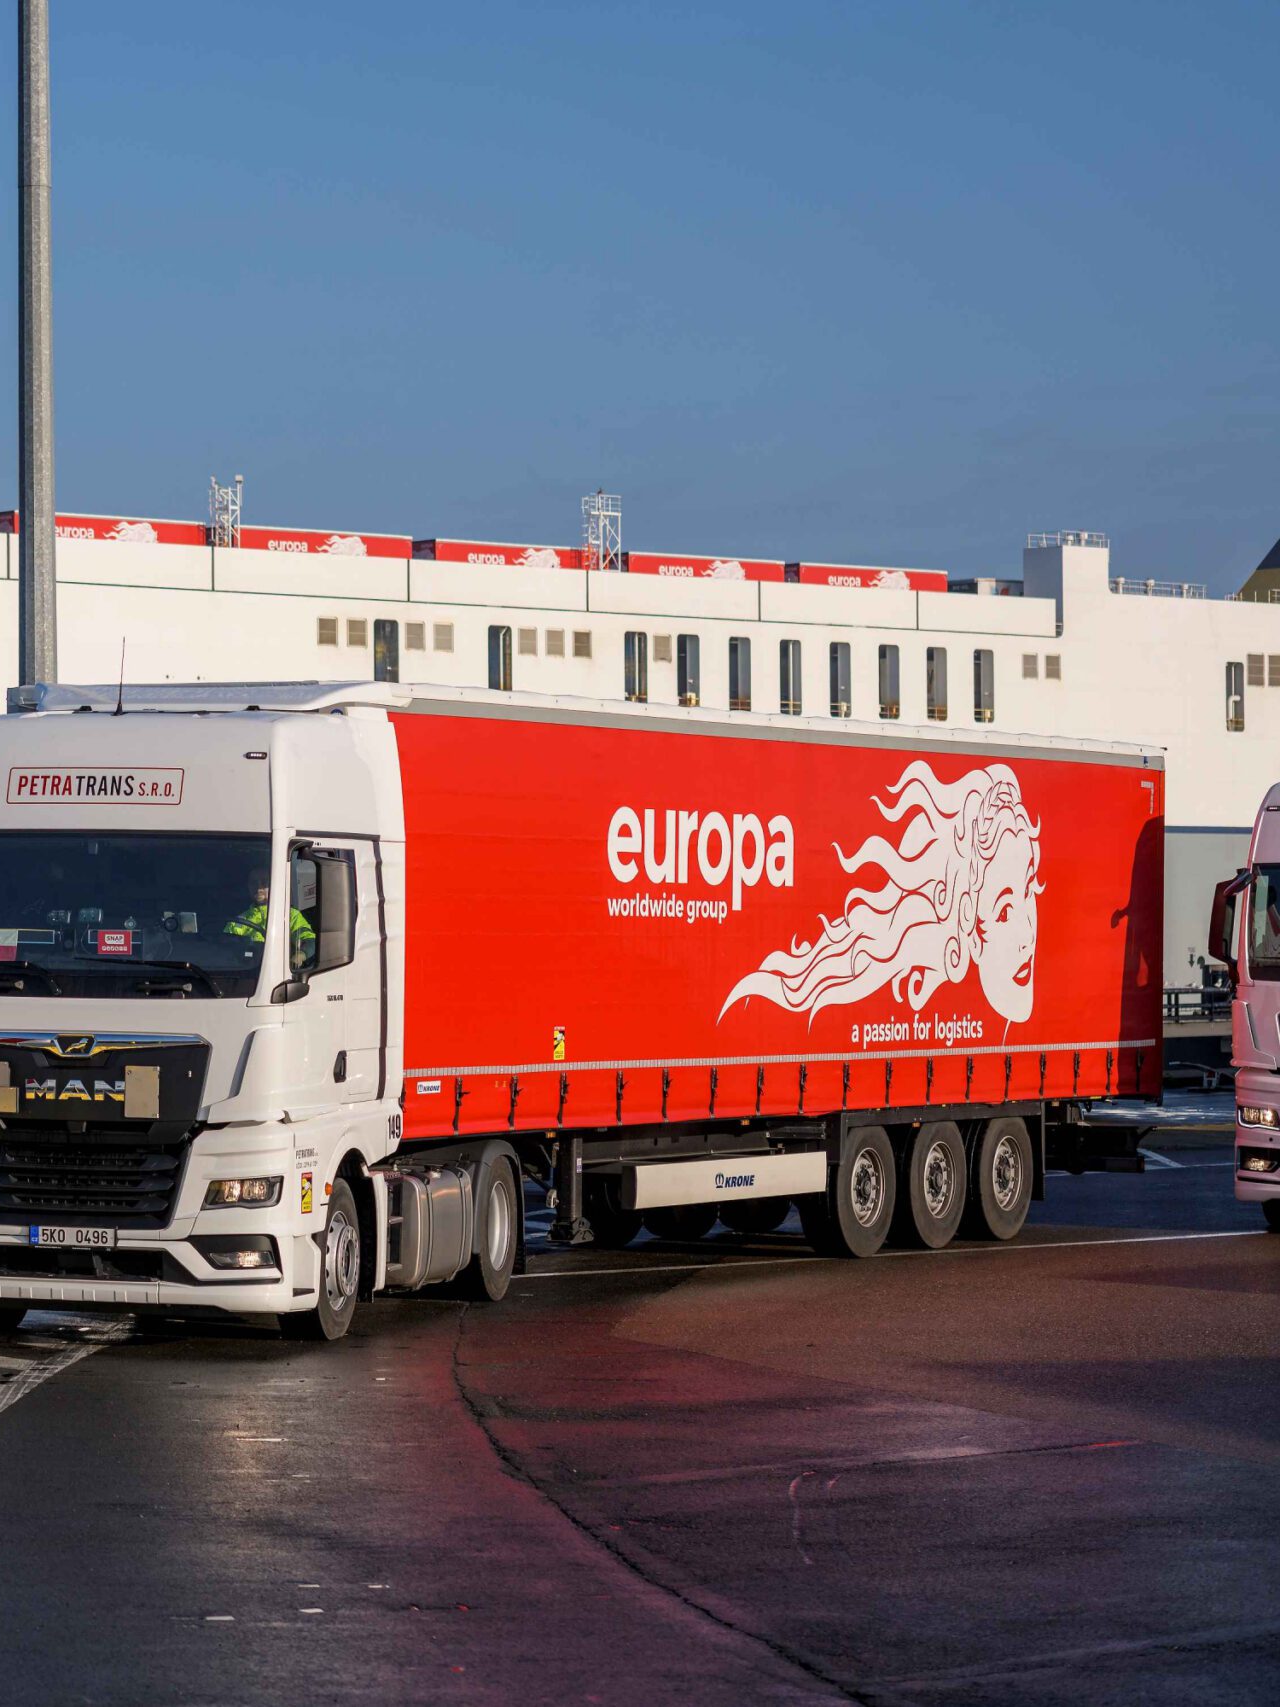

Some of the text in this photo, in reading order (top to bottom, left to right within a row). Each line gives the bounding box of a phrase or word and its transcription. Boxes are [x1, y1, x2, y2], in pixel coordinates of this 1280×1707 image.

[267, 540, 309, 552] europa
[467, 553, 506, 565] europa
[658, 565, 694, 577] europa
[827, 575, 862, 587] europa
[17, 775, 175, 797] PETRATRANS S.R.O.
[607, 806, 795, 911] europa
[607, 893, 728, 925] worldwide group
[851, 1013, 983, 1050] a passion for logistics
[25, 1079, 125, 1102] MAN
[388, 1114, 401, 1140] 149
[724, 1174, 755, 1188] KRONE
[42, 1228, 66, 1243] 5K0
[75, 1230, 109, 1245] 0496
